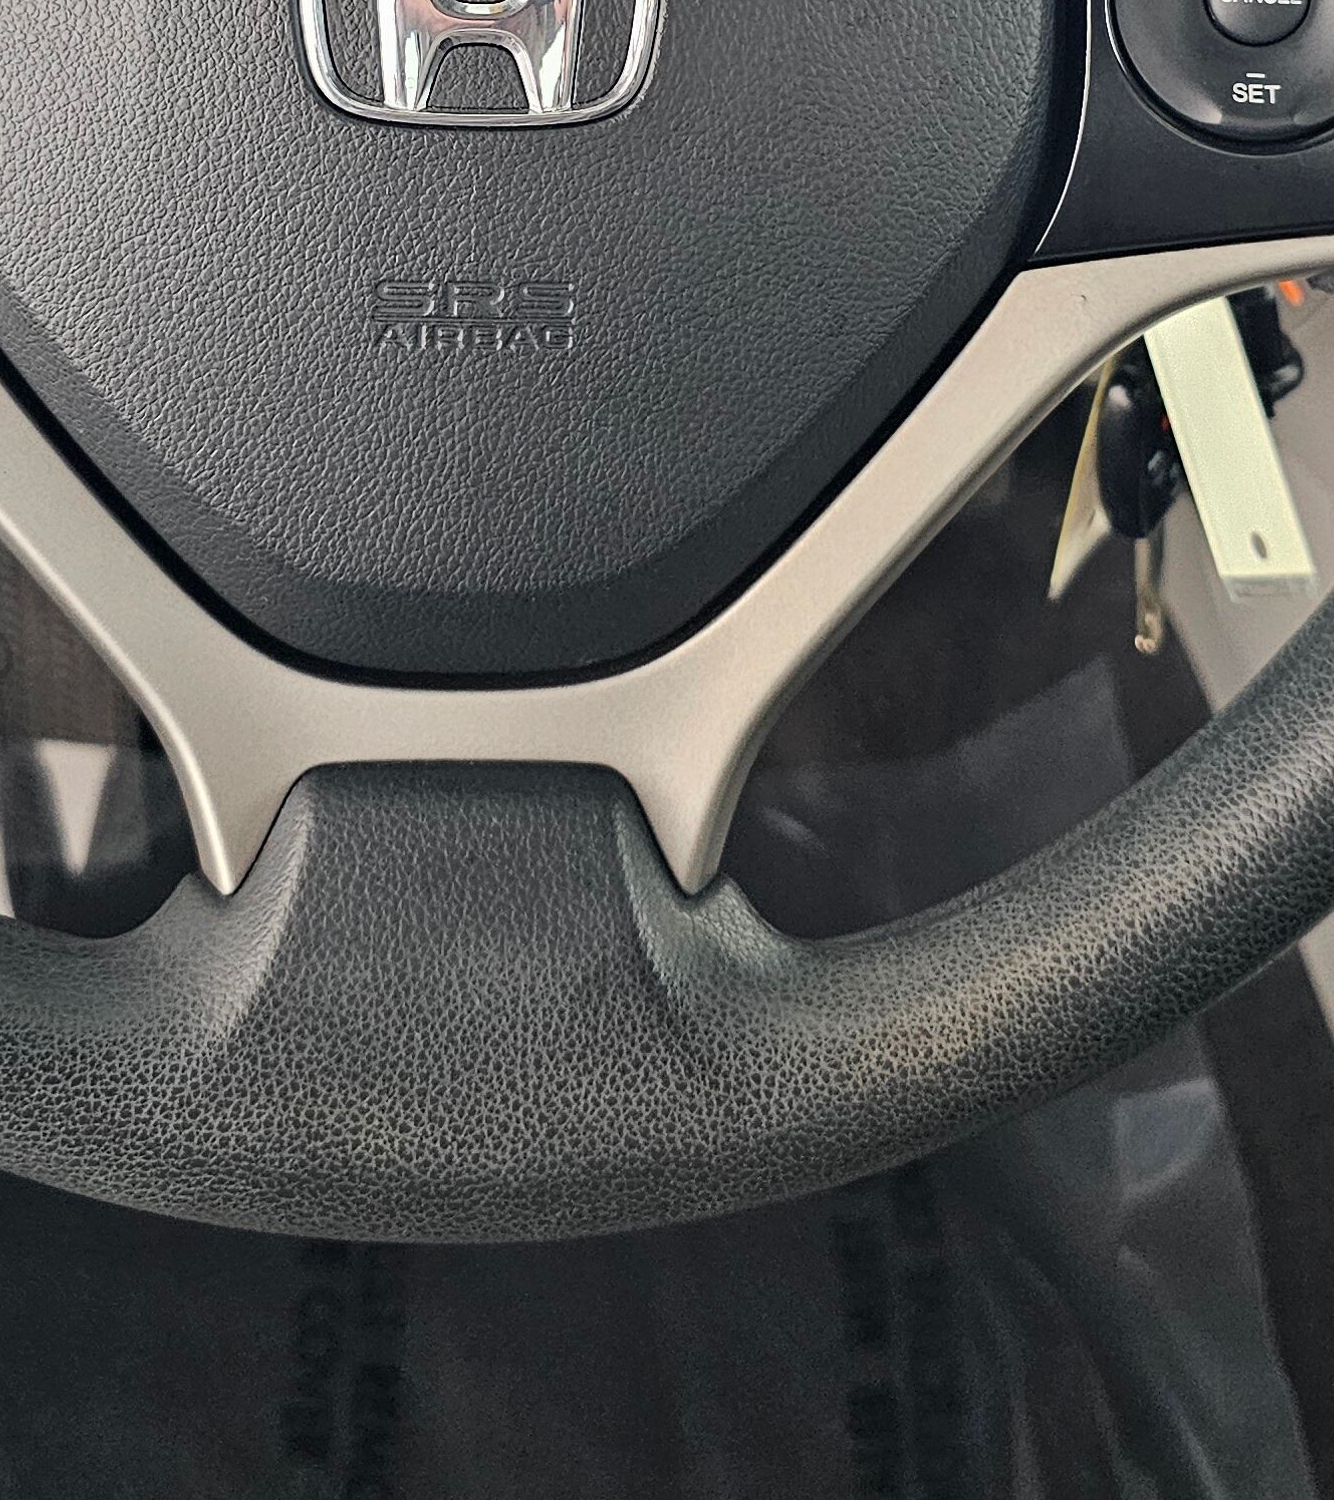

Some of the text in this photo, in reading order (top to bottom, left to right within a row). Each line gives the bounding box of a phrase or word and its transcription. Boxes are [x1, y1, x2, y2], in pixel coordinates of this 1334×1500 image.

[1231, 83, 1282, 104] SET
[373, 281, 575, 316] SRS
[374, 323, 575, 351] AIRBAG
